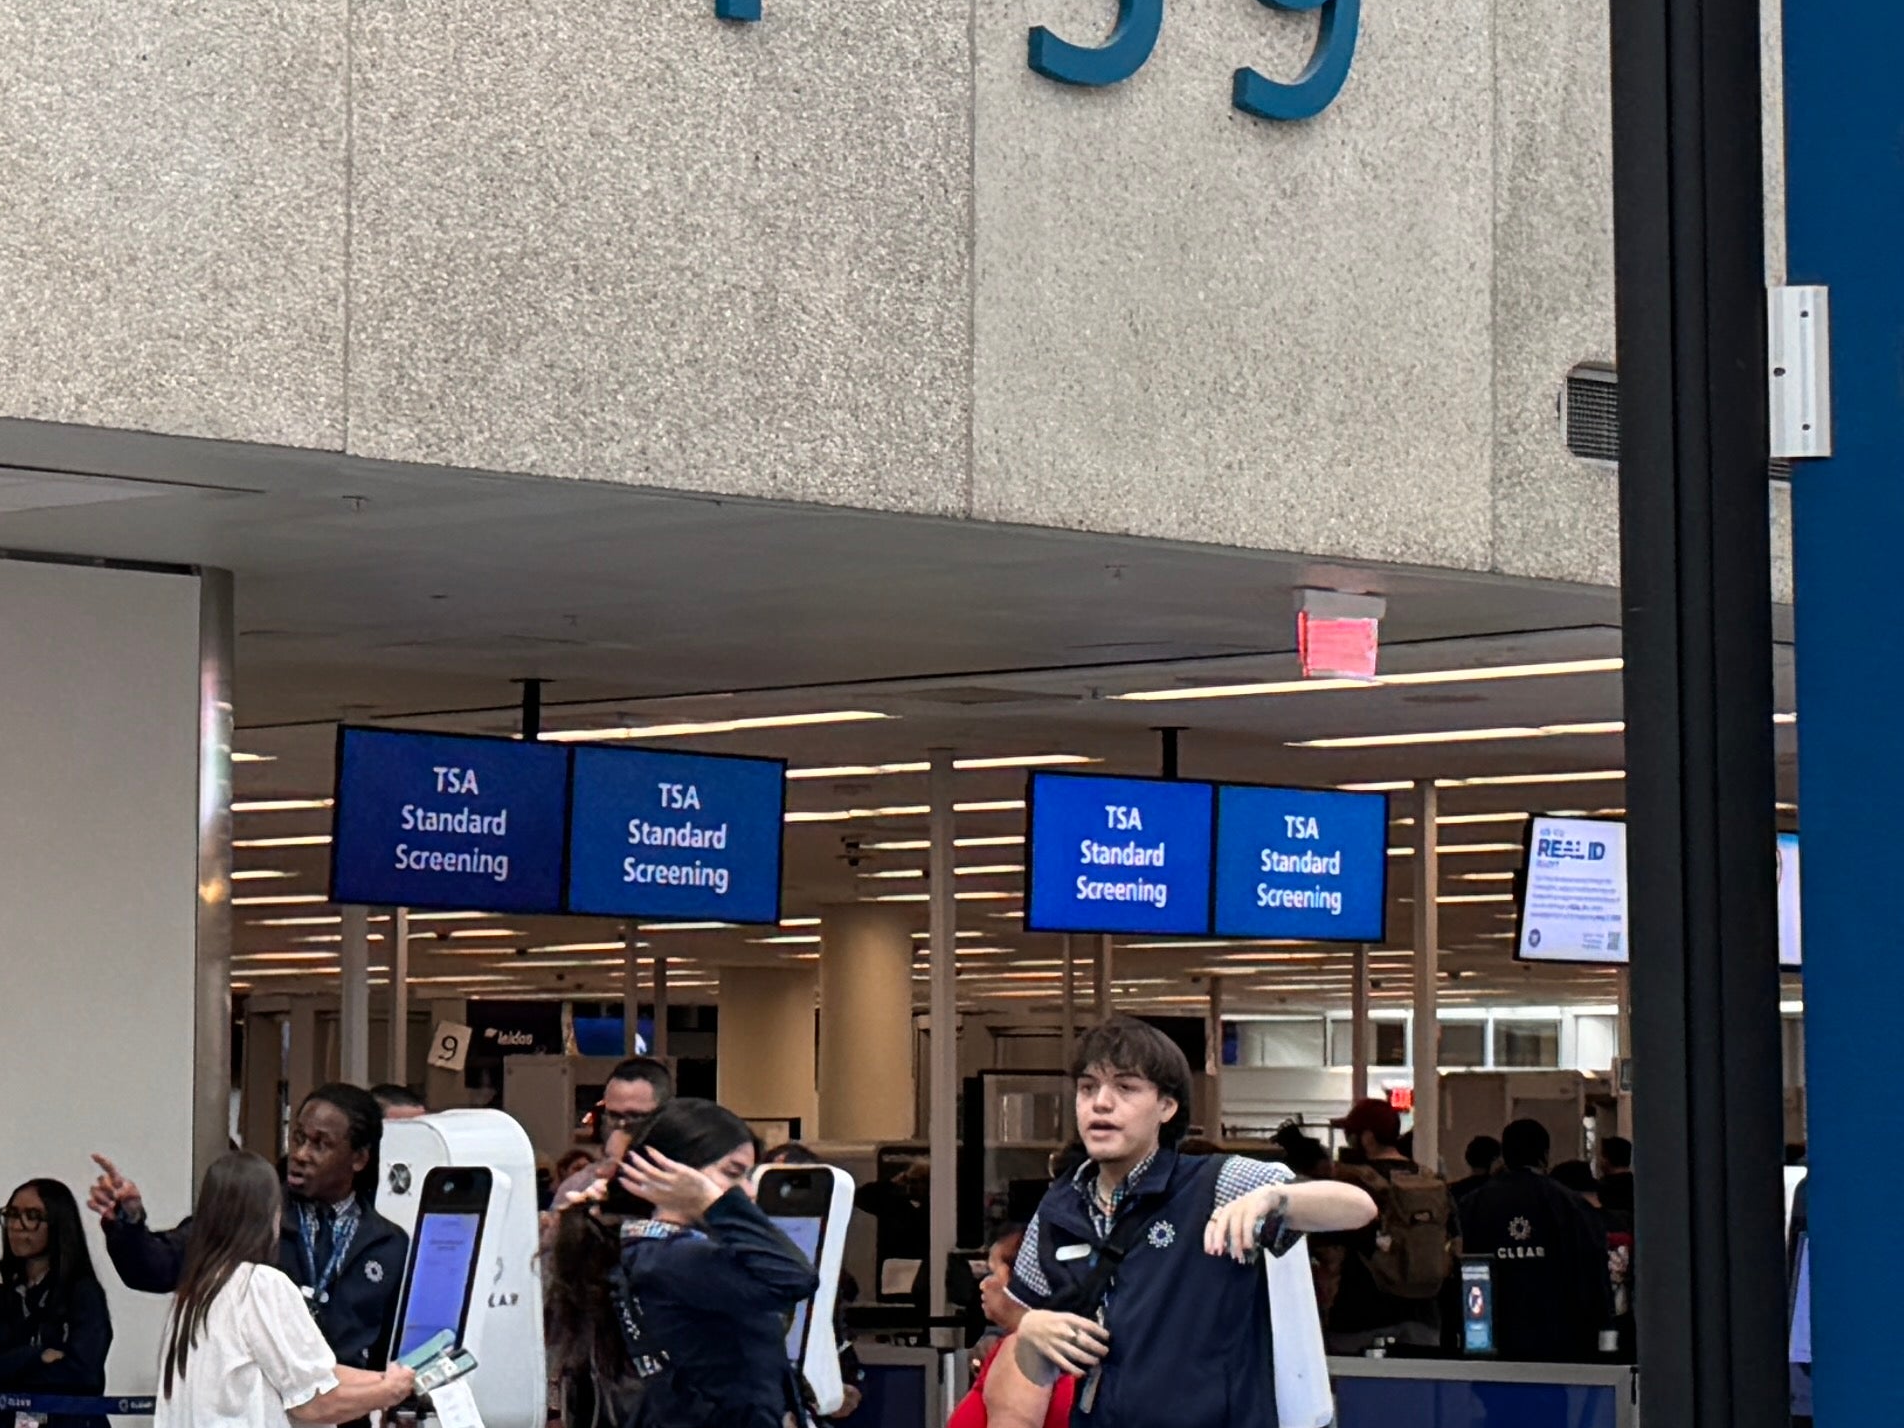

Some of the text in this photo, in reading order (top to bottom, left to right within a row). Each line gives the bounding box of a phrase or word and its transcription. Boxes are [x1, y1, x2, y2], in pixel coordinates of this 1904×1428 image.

[433, 766, 479, 796] TSA
[658, 782, 701, 811] TSA
[401, 804, 507, 836] Standard
[1105, 805, 1143, 831] TSA
[1284, 815, 1320, 840] TSA
[628, 819, 727, 850] Standard
[395, 844, 509, 882] Screening
[1080, 839, 1165, 867] Standard
[1261, 848, 1340, 875] Standard
[1587, 841, 1606, 861] ID
[623, 857, 729, 894] Screening
[1076, 875, 1168, 908] Screening
[1257, 883, 1342, 915] Screening
[438, 1035, 459, 1061] 9
[1497, 1246, 1545, 1259] CLEAR
